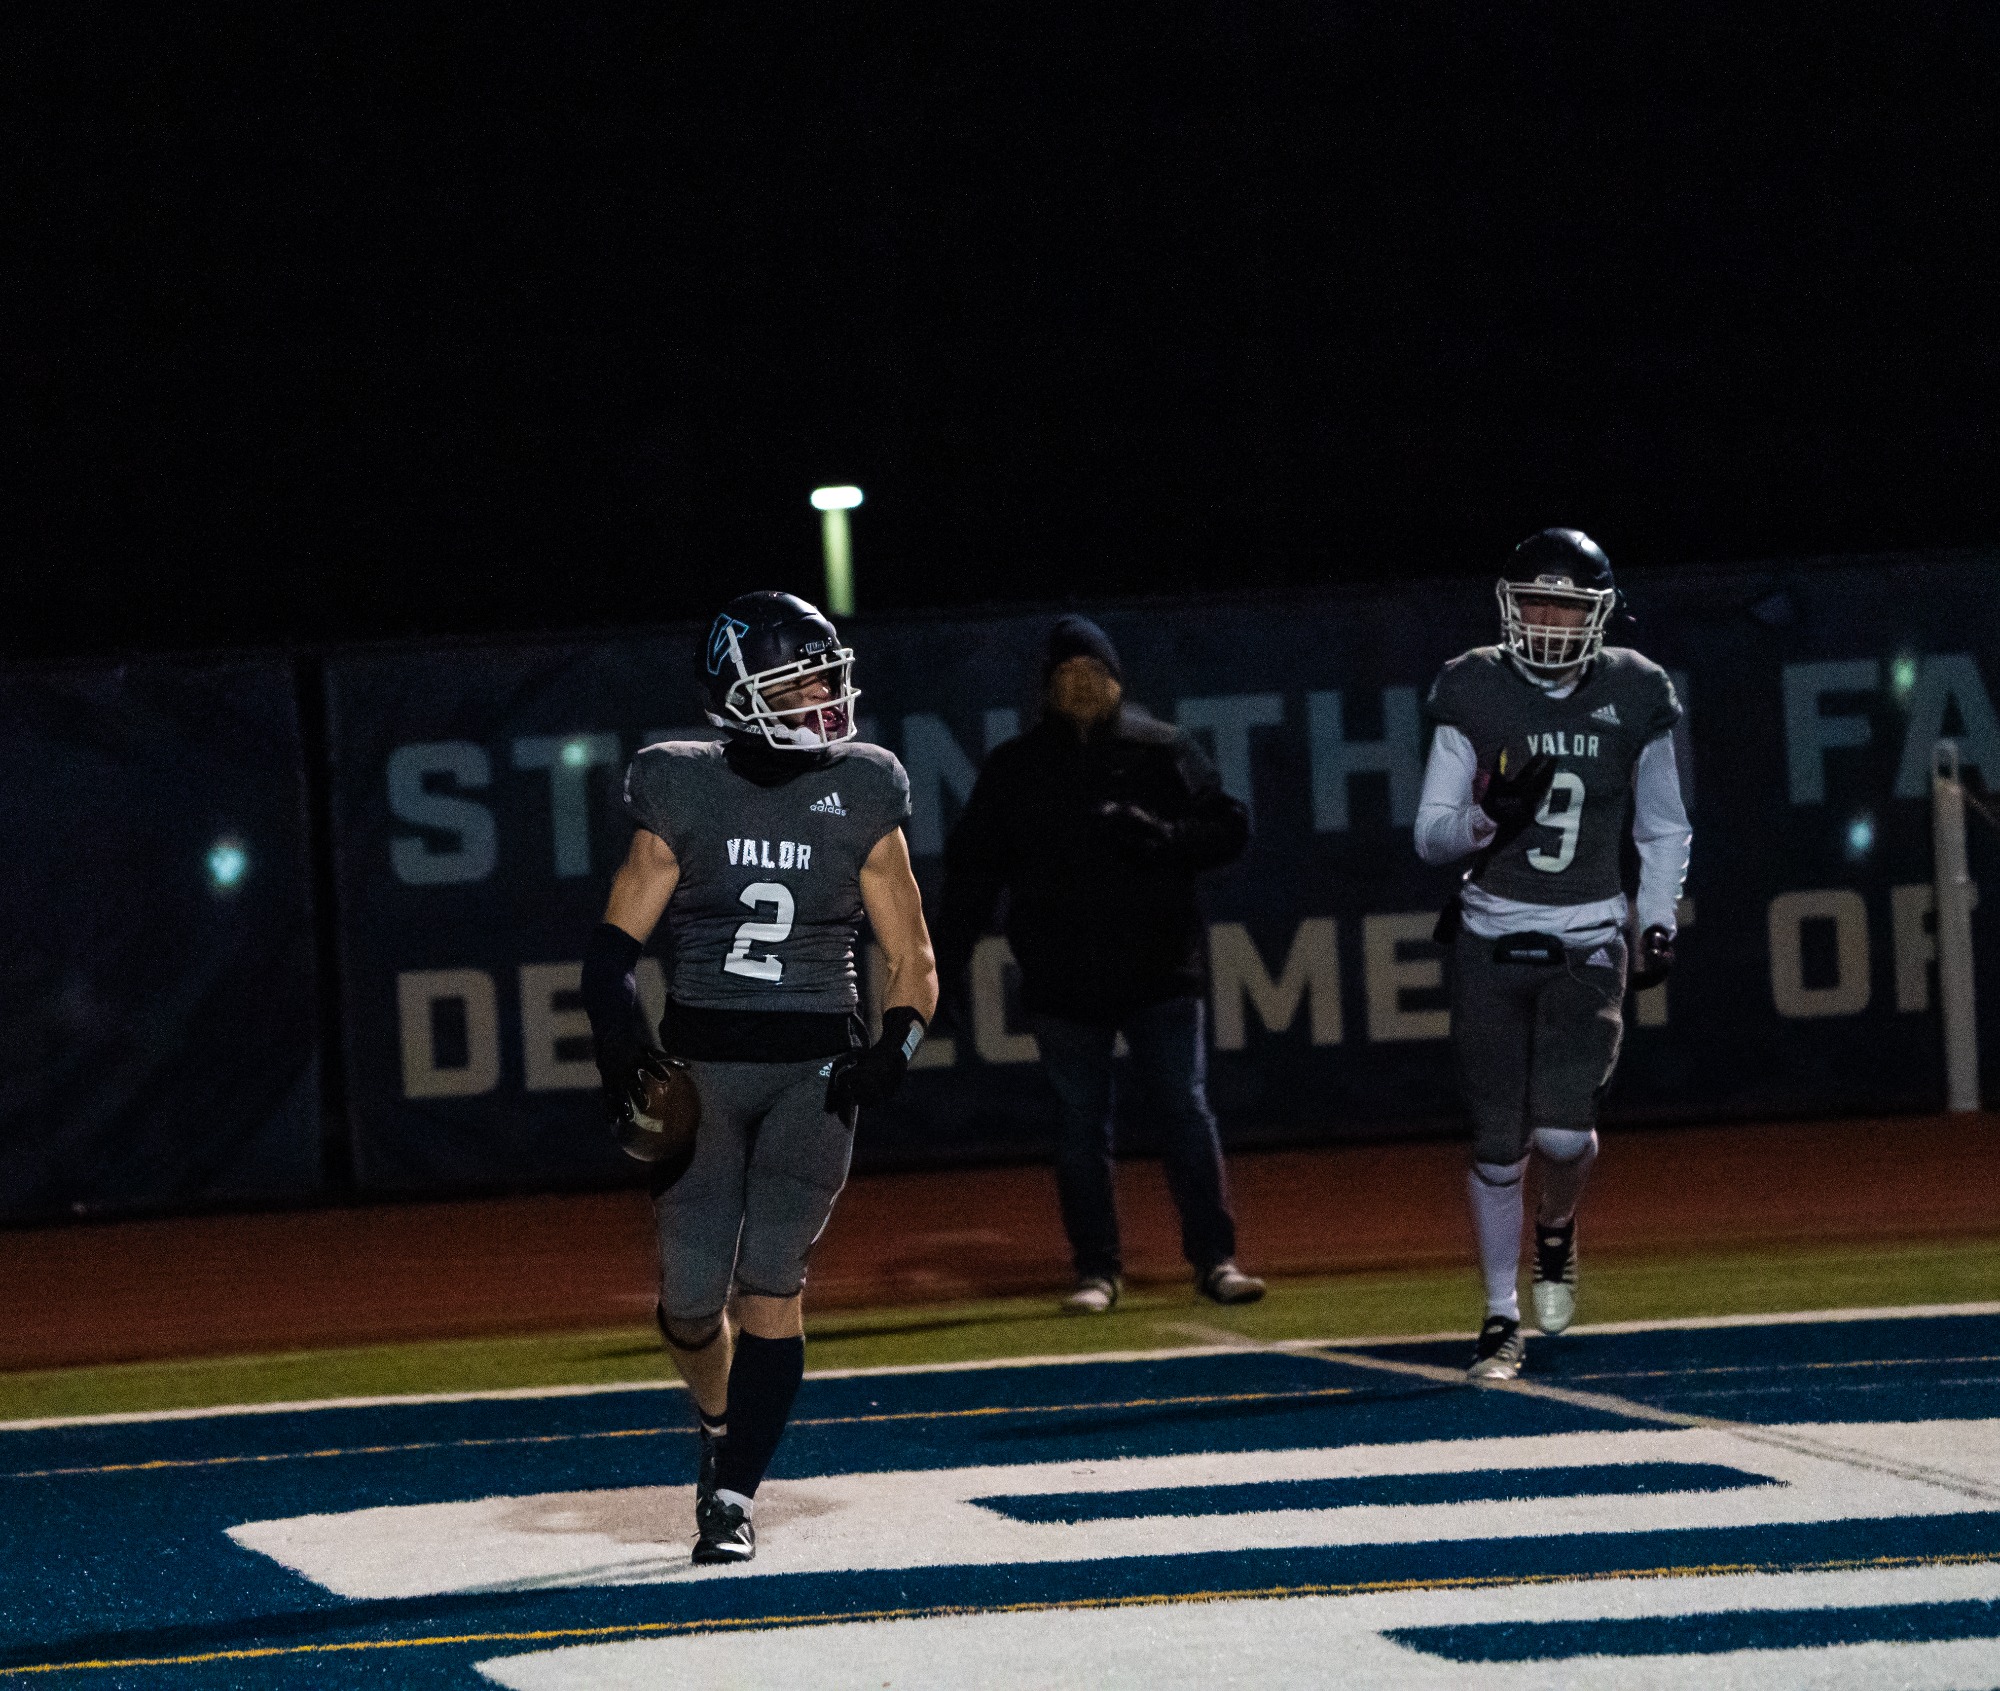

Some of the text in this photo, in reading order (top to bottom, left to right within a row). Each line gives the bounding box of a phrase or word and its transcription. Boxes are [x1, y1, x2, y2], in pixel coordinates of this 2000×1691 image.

[1527, 731, 1600, 758] VALOR
[809, 801, 848, 817] adidas
[1526, 772, 1587, 874] 9
[726, 838, 812, 870] VALOR
[723, 882, 796, 982] 2
